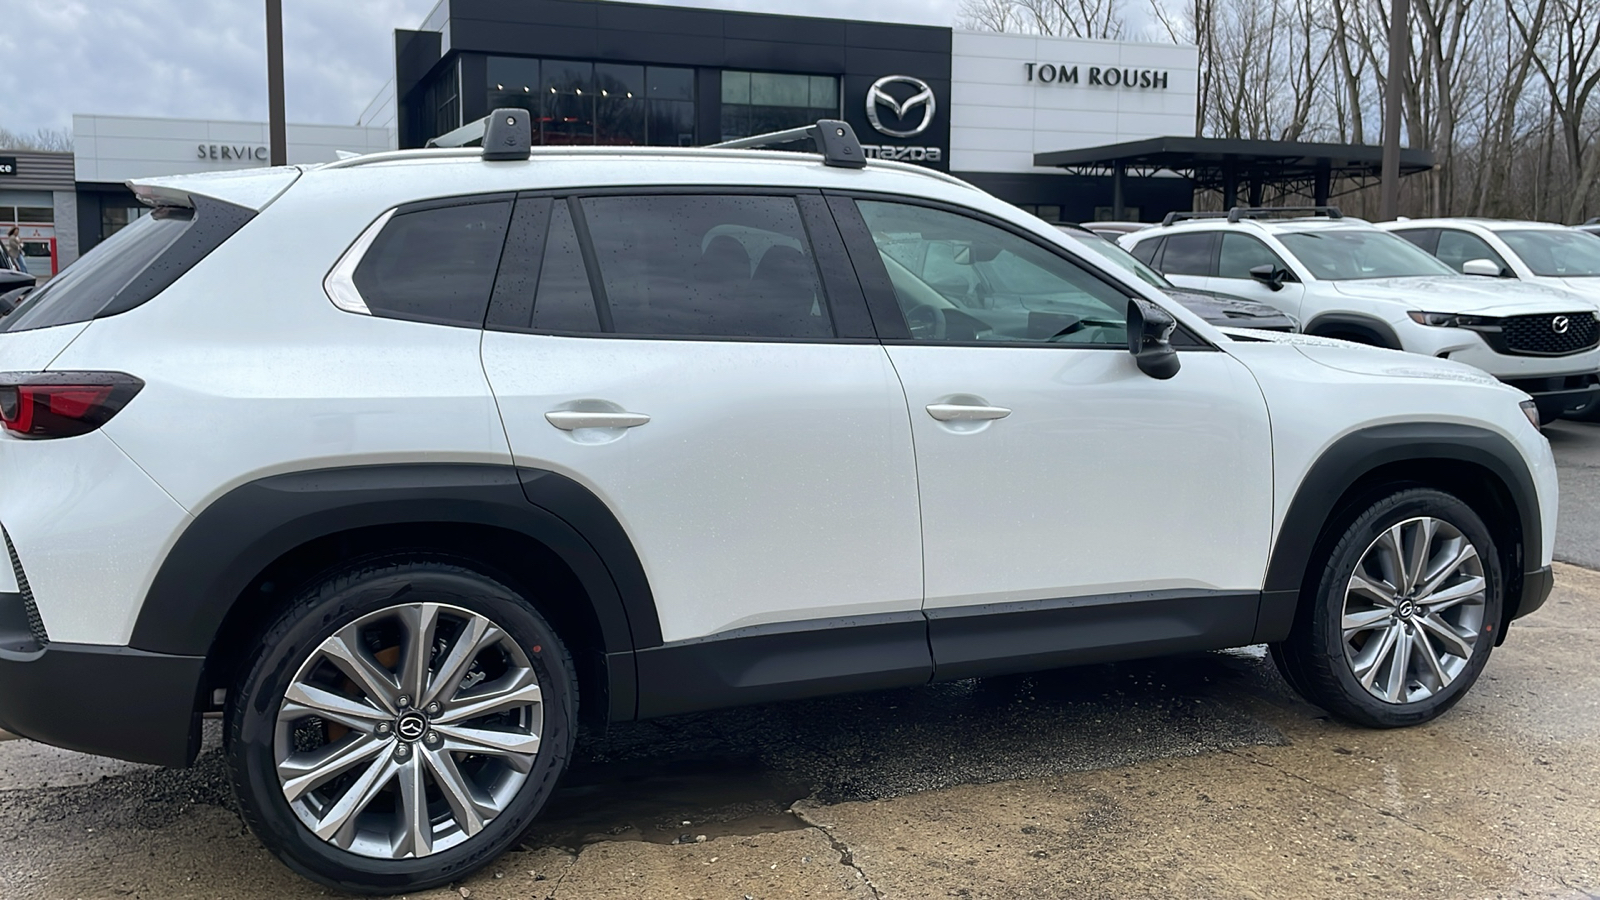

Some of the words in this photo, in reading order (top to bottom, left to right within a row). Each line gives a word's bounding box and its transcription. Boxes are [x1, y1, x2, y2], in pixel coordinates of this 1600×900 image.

[1024, 62, 1079, 84] TOM
[1089, 66, 1168, 89] ROUSH
[197, 144, 268, 161] SERVIC
